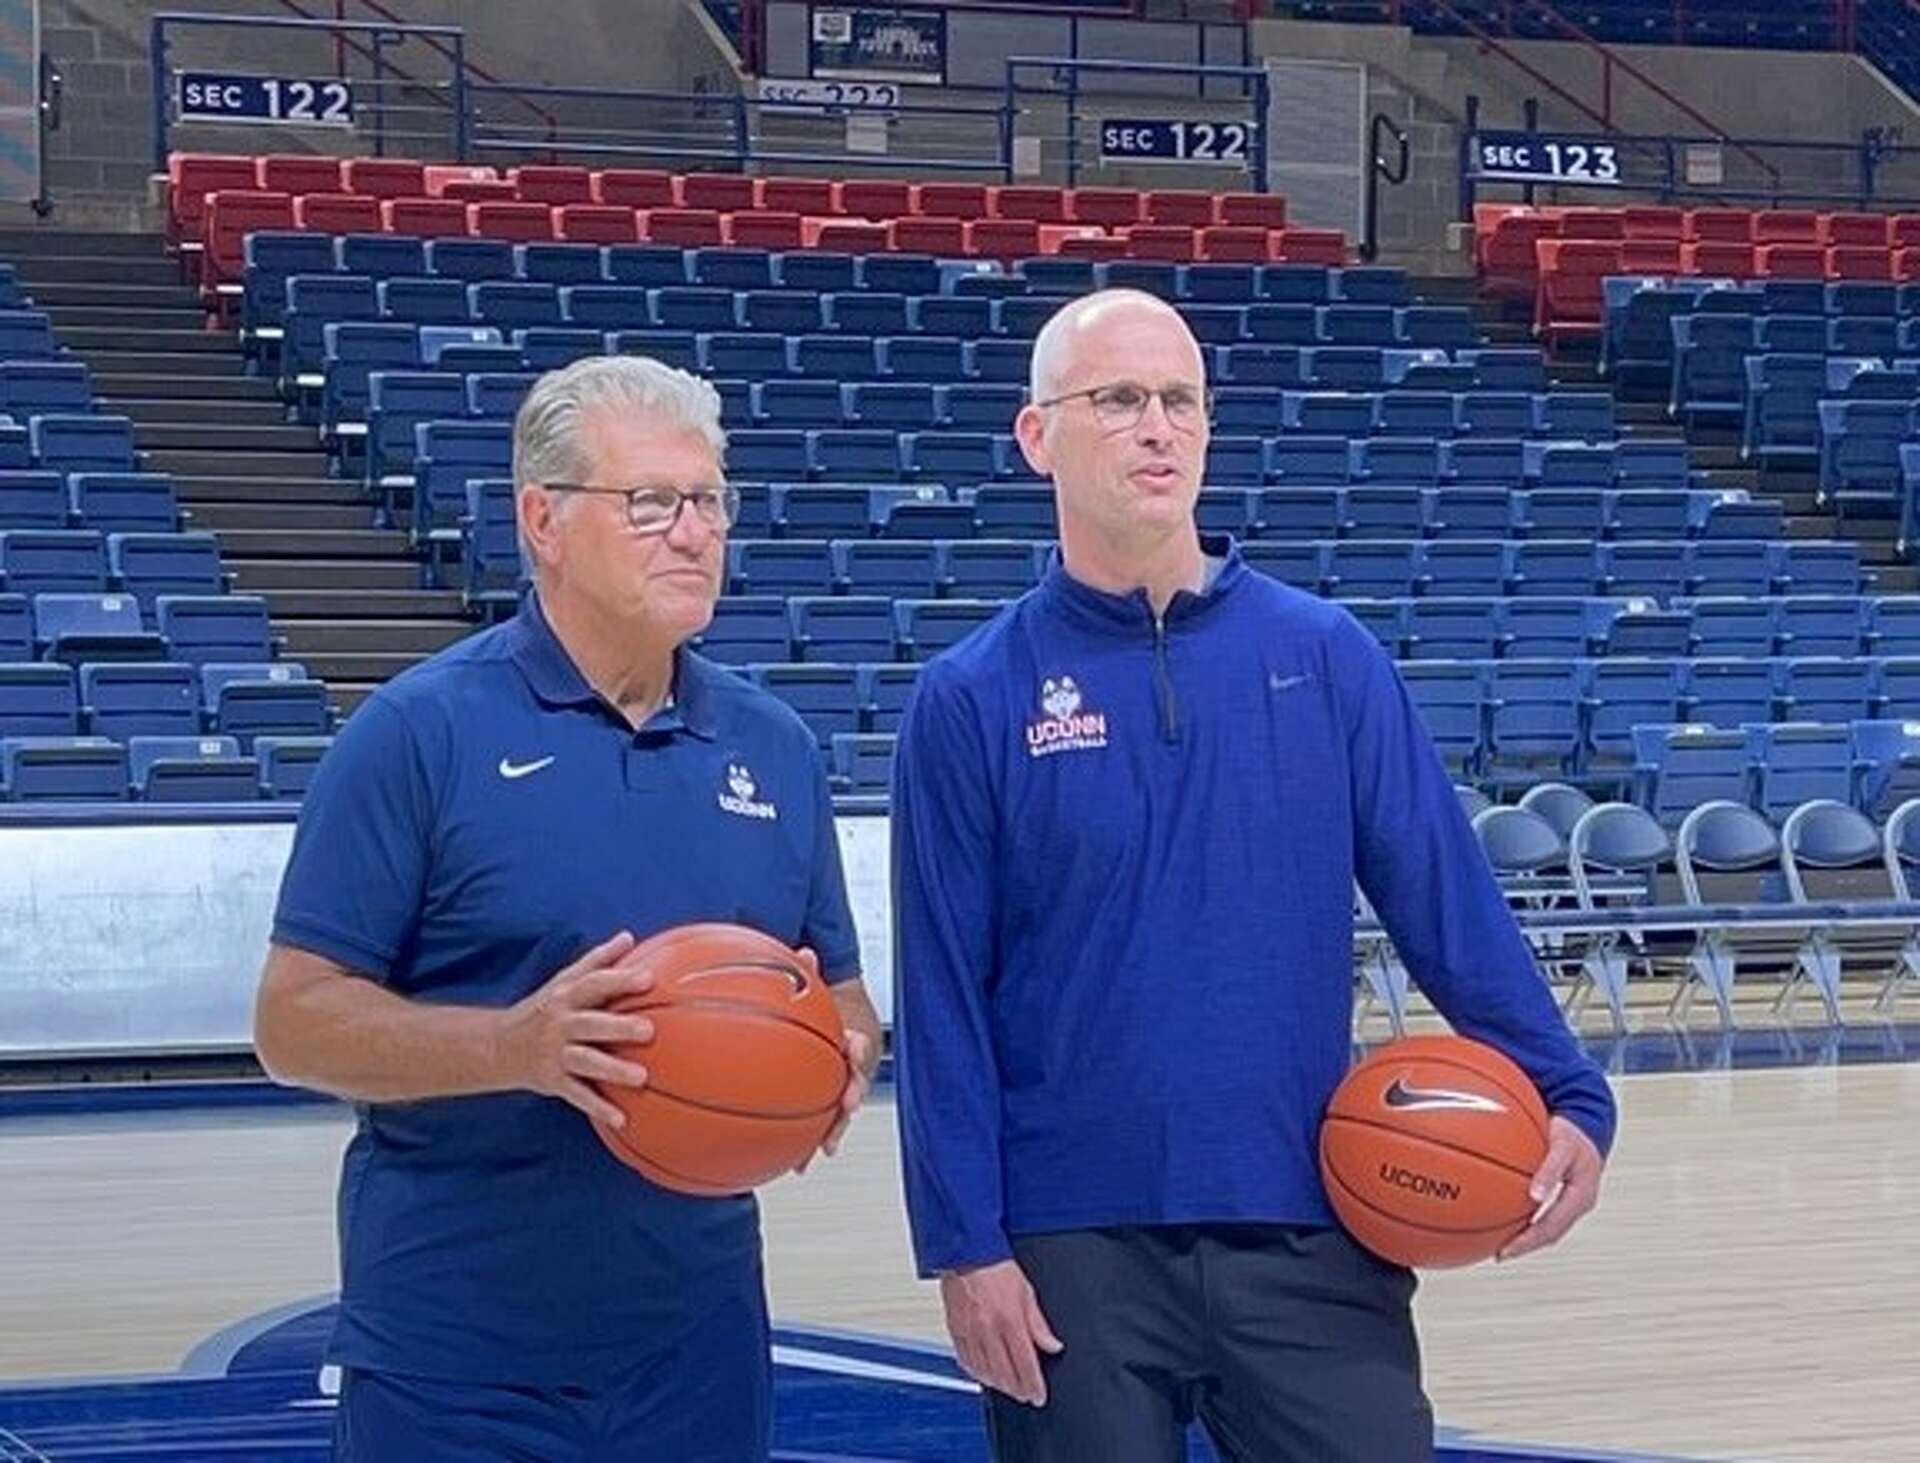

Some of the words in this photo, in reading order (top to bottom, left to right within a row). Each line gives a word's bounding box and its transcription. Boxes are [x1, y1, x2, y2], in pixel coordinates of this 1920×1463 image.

[185, 83, 243, 109] SEC
[261, 79, 350, 121] 122
[1104, 128, 1155, 151] SEC
[1169, 122, 1246, 159] 122
[1483, 144, 1531, 166] SEC
[1545, 142, 1618, 179] 123
[1026, 714, 1107, 745] UCONN
[718, 793, 778, 820] UCONN
[1378, 1162, 1462, 1201] UCONN
